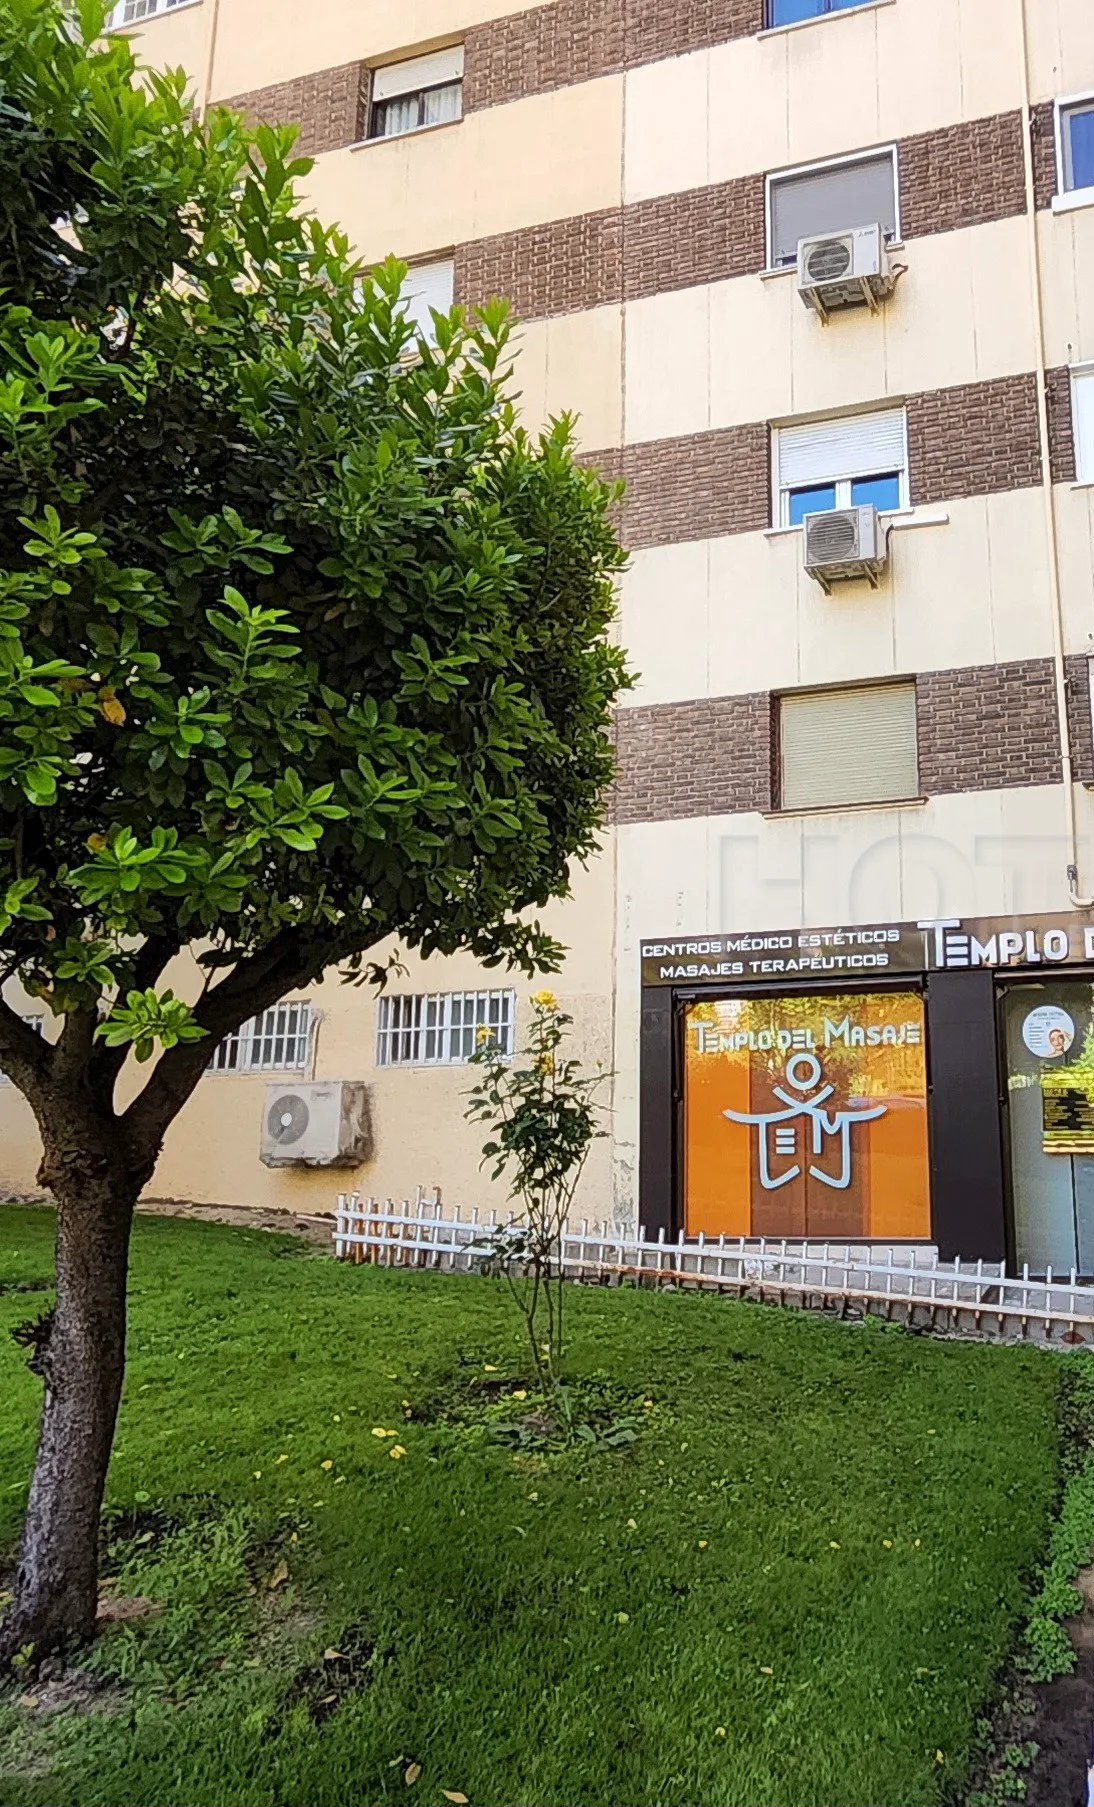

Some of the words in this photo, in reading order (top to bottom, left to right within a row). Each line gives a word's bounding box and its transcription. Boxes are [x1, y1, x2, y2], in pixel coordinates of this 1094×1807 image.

[642, 940, 722, 958] CENTROS
[727, 935, 793, 953] MÉDICO
[798, 929, 900, 948] ESTÉTICOS
[917, 919, 1070, 968] TEMPLO
[659, 961, 744, 979] MASAJES
[688, 1021, 774, 1053] TEMPLO
[778, 1028, 815, 1050] DEL
[823, 1015, 921, 1049] MASAJE
